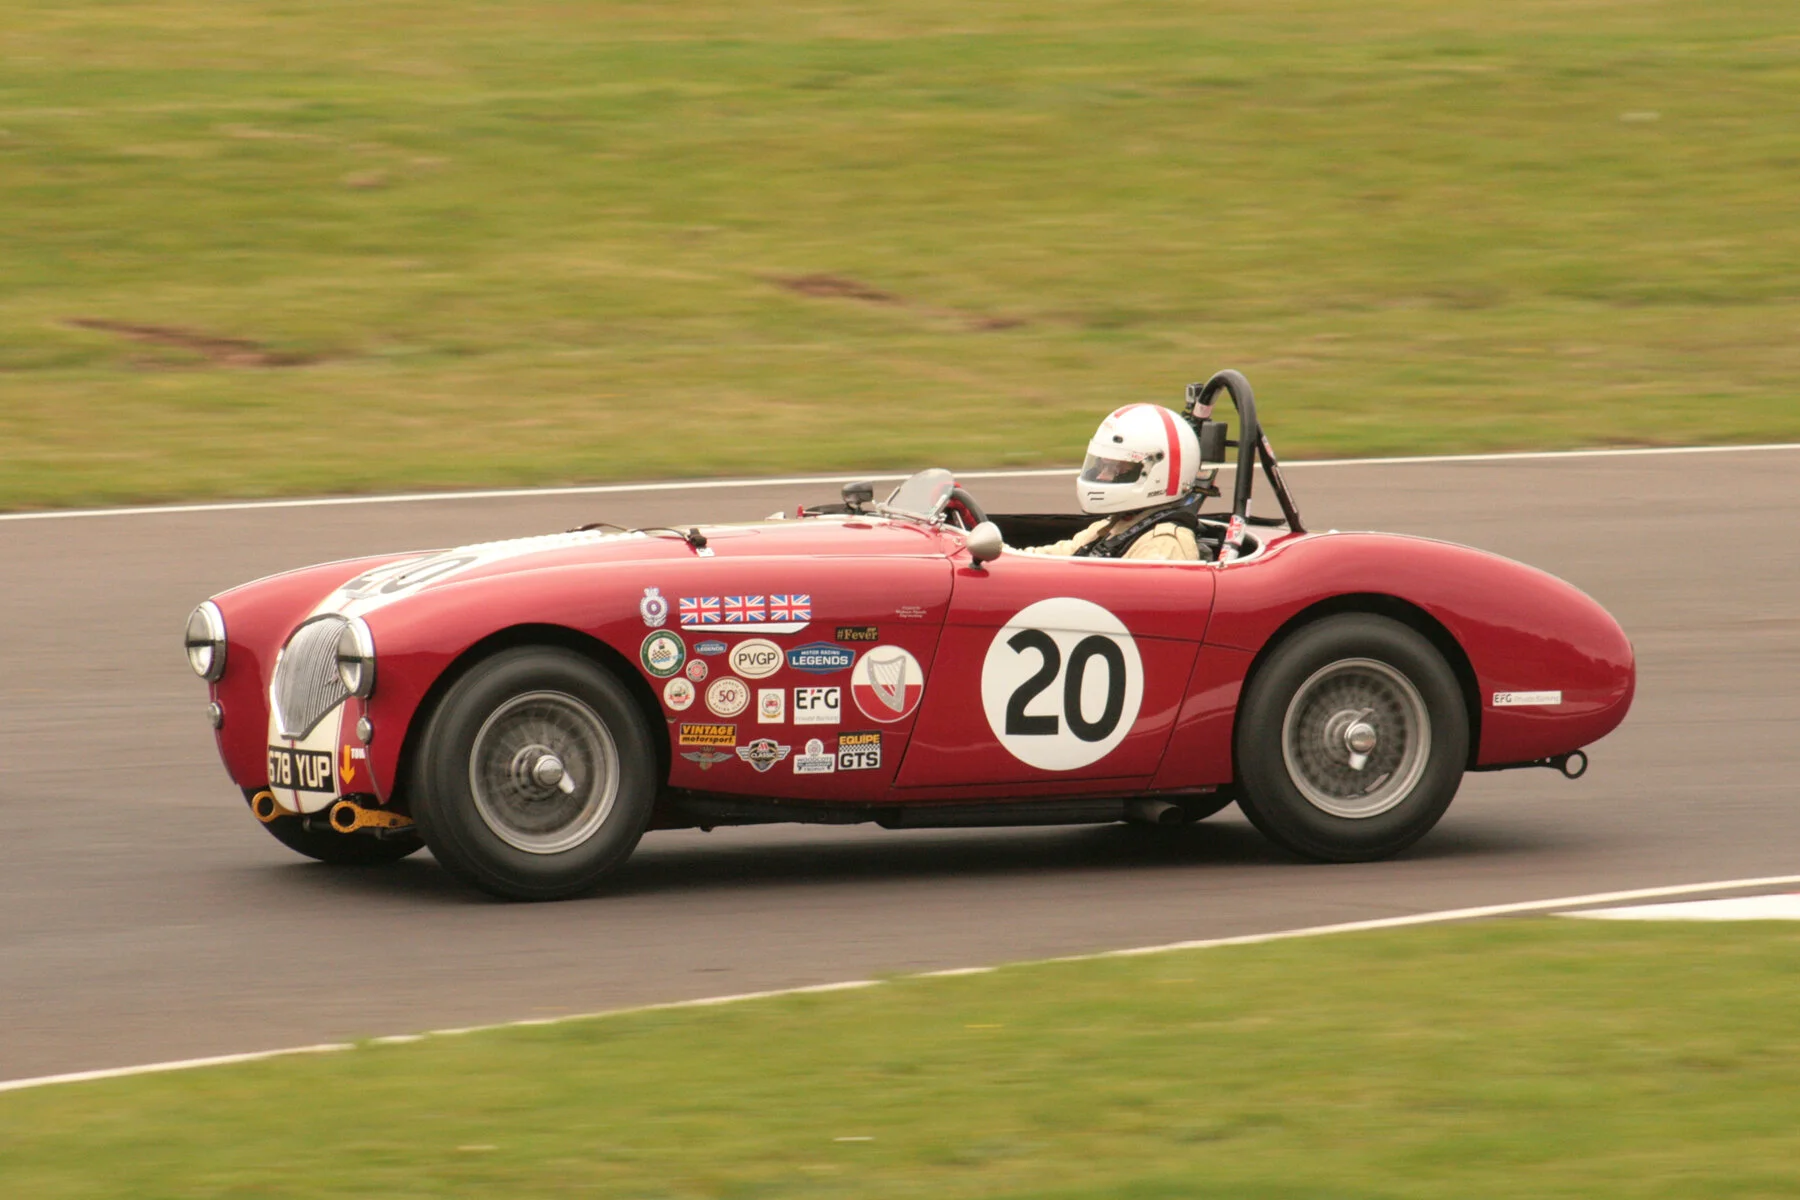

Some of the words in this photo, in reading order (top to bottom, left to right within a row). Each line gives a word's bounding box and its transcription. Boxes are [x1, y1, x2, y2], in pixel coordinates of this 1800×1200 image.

[738, 652, 776, 666] PVGP
[792, 656, 849, 666] LEGENDS
[1005, 628, 1127, 743] 20
[718, 690, 735, 703] 50
[796, 688, 839, 709] EFG
[1494, 694, 1512, 703] EFG
[682, 725, 734, 735] VINTAGE
[839, 734, 880, 745] EQUIPE
[840, 751, 878, 768] GTS
[295, 754, 331, 788] YUP
